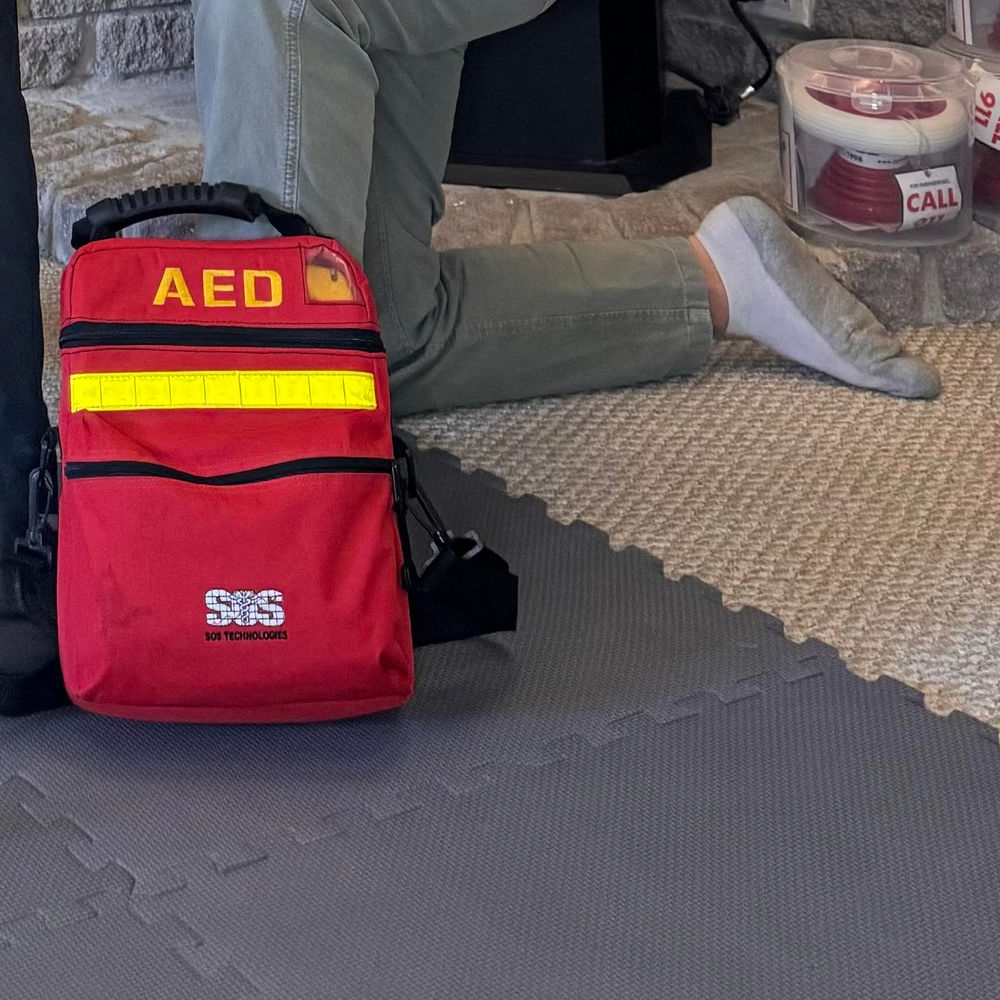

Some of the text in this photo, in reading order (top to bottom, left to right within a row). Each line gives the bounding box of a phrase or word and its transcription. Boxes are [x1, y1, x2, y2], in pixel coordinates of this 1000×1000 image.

[907, 188, 958, 213] CALL
[152, 267, 283, 308] AED
[204, 588, 285, 626] SOS
[205, 630, 288, 641] SOS TECHNOLOGIES
